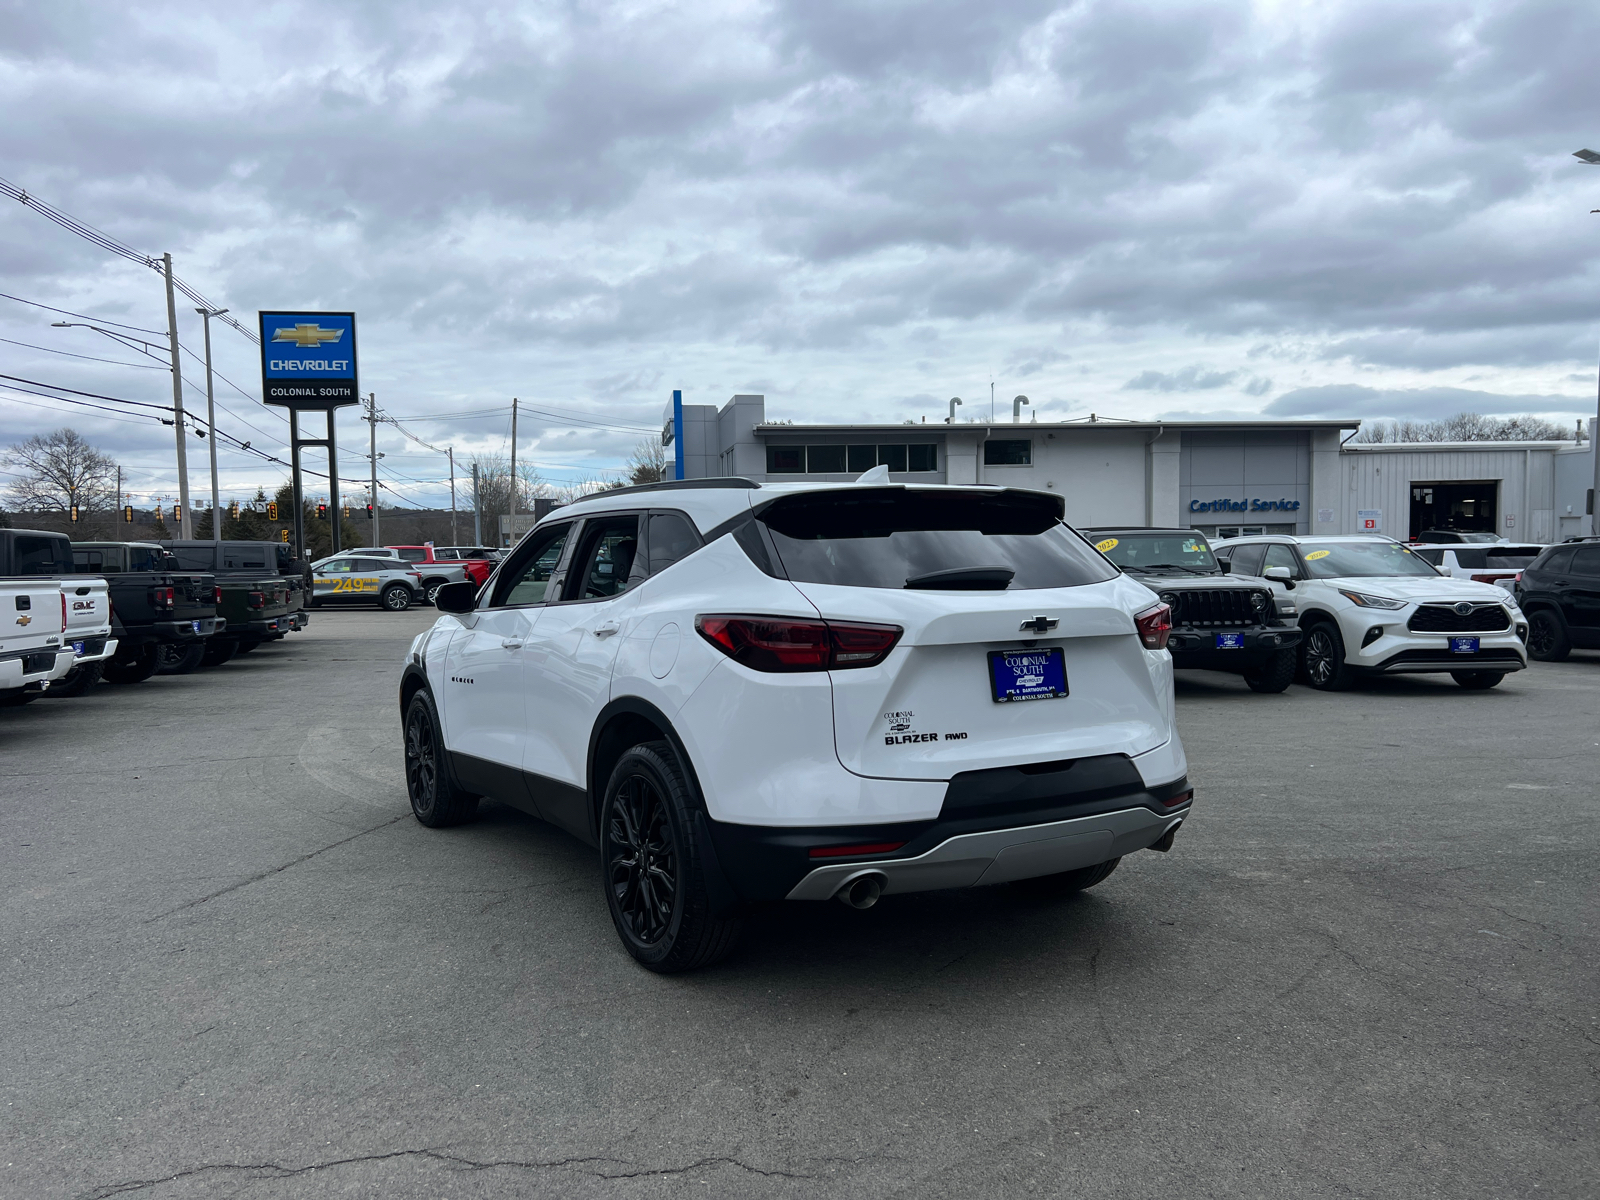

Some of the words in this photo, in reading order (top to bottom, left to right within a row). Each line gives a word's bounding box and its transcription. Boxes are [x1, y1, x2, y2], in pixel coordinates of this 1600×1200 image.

[270, 360, 349, 371] CHEVROLET
[270, 387, 317, 396] COLONIAL
[319, 388, 351, 396] SOUTH
[1190, 499, 1248, 512] Certified
[1252, 498, 1300, 511] Service
[1366, 520, 1373, 528] 3
[73, 601, 96, 610] GMC
[1006, 656, 1048, 667] COLONIAL
[1014, 666, 1044, 676] SOUTH
[884, 711, 915, 719] COLONIAL
[885, 733, 938, 745] BLAZER
[945, 732, 968, 741] AWD
